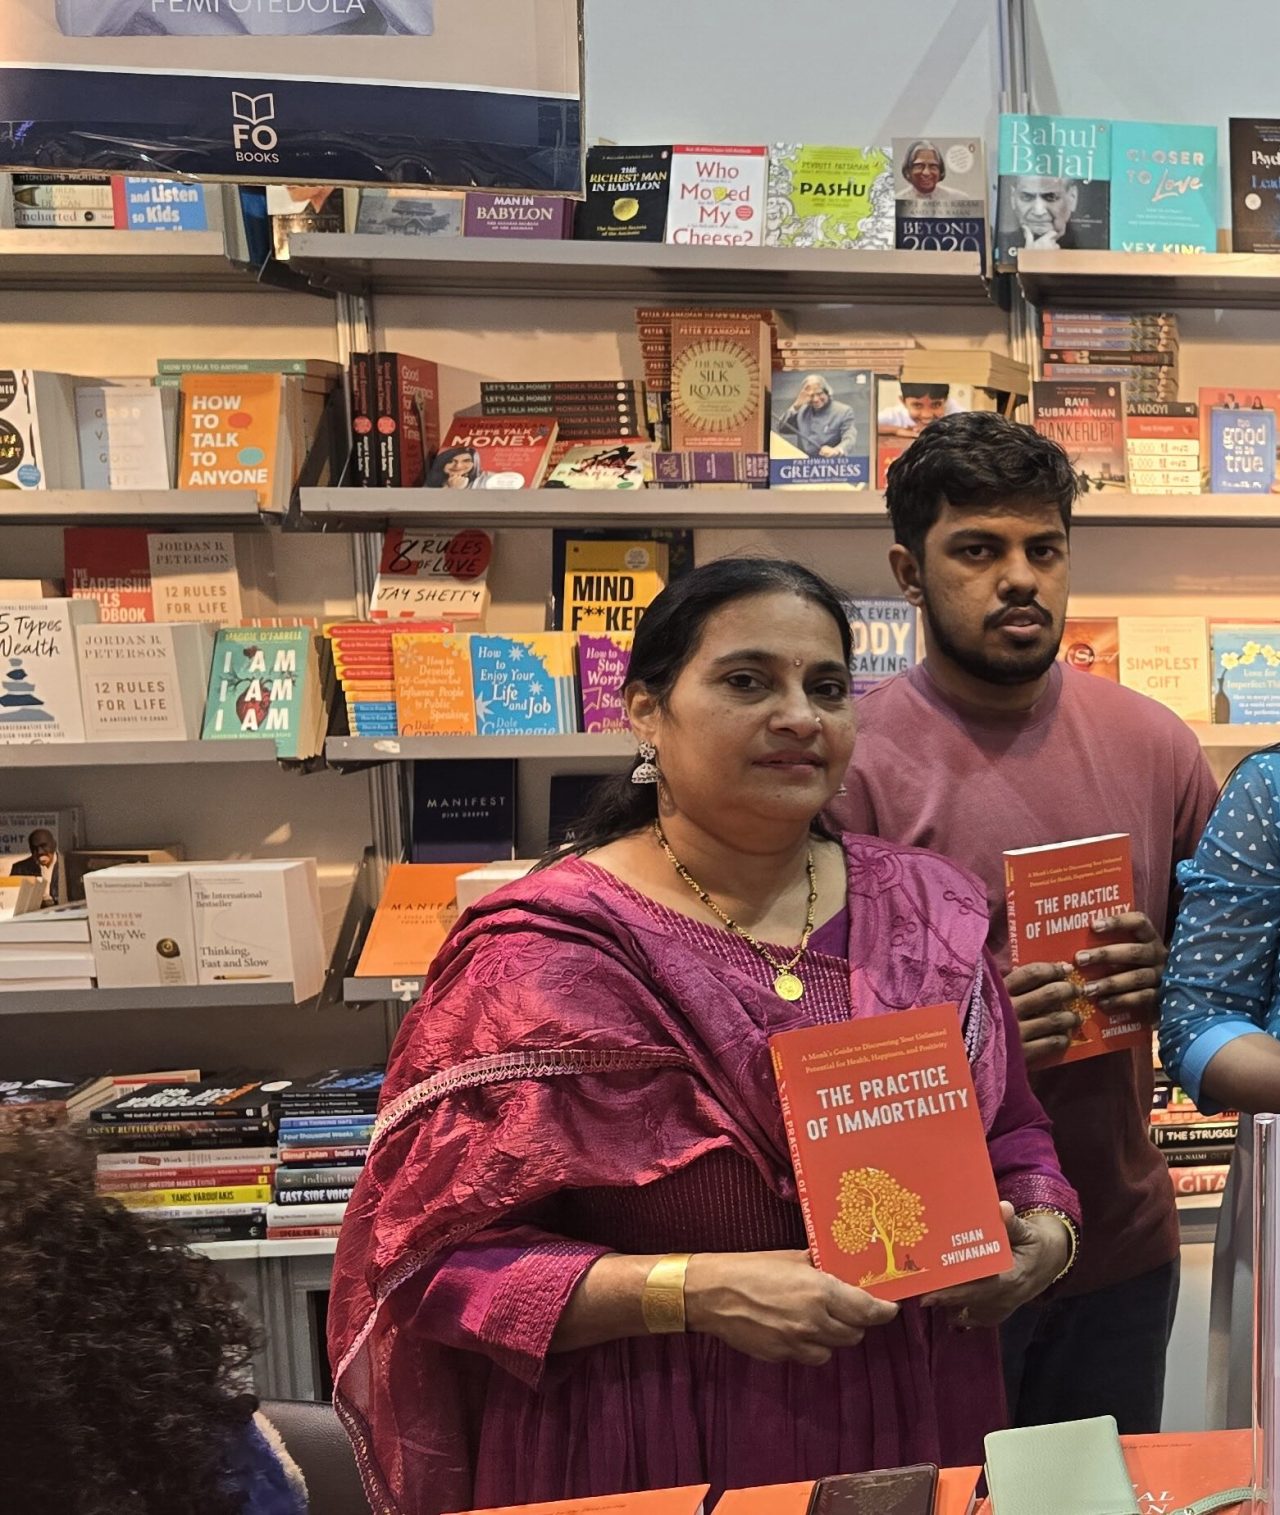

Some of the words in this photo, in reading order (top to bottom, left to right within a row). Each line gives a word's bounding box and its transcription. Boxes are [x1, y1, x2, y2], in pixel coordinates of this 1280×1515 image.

[233, 123, 278, 151] FO
[1011, 120, 1097, 149] Rahul
[236, 152, 280, 164] BOOKS
[1010, 146, 1094, 184] Bajaj
[590, 173, 638, 183] RICHEST
[641, 171, 667, 181] MAN
[696, 161, 739, 179] Who
[130, 194, 149, 203] and
[152, 186, 198, 202] Listen
[132, 214, 143, 223] so
[147, 208, 180, 223] Kids
[476, 207, 553, 221] BABYLON
[700, 206, 730, 226] My
[903, 222, 980, 236] BEYOND
[192, 395, 241, 411] HOW
[192, 414, 219, 428] TO
[1038, 408, 1116, 419] SUBRAMANIAN
[191, 433, 240, 448] TALK
[450, 435, 545, 448] MONEY
[190, 451, 217, 466] TO
[189, 469, 268, 486] ANYONE
[780, 464, 862, 479] GREATNESS
[432, 558, 477, 573] LOVE
[377, 587, 411, 600] JAY
[415, 588, 480, 602] SHETTY
[572, 575, 634, 602] MIND
[478, 647, 501, 659] How
[1126, 657, 1200, 670] SIMPLEST
[480, 670, 509, 684] Enjoy
[511, 671, 535, 682] Your
[1146, 675, 1180, 689] GIFT
[95, 682, 109, 694] 12
[117, 681, 166, 694] RULES
[492, 684, 518, 706] Life
[98, 700, 127, 711] FOR
[134, 698, 167, 711] LIFE
[509, 701, 527, 711] and
[527, 697, 552, 718] Job
[426, 796, 507, 809] MANIFEST
[1035, 896, 1060, 915] THE
[1064, 885, 1119, 910] PRACTICE
[98, 929, 124, 943] Why
[126, 929, 147, 941] We
[1025, 922, 1042, 940] OF
[199, 945, 251, 960] Thinking,
[201, 958, 220, 970] Fast
[222, 957, 241, 968] and
[243, 956, 269, 968] Slow
[817, 1084, 854, 1110] THE
[859, 1065, 950, 1102] PRACTICE
[806, 1116, 828, 1141] OF
[836, 1088, 969, 1135] IMMORTALITY
[951, 1228, 984, 1246] ISHAN
[941, 1240, 1001, 1267] SHIVANAND
